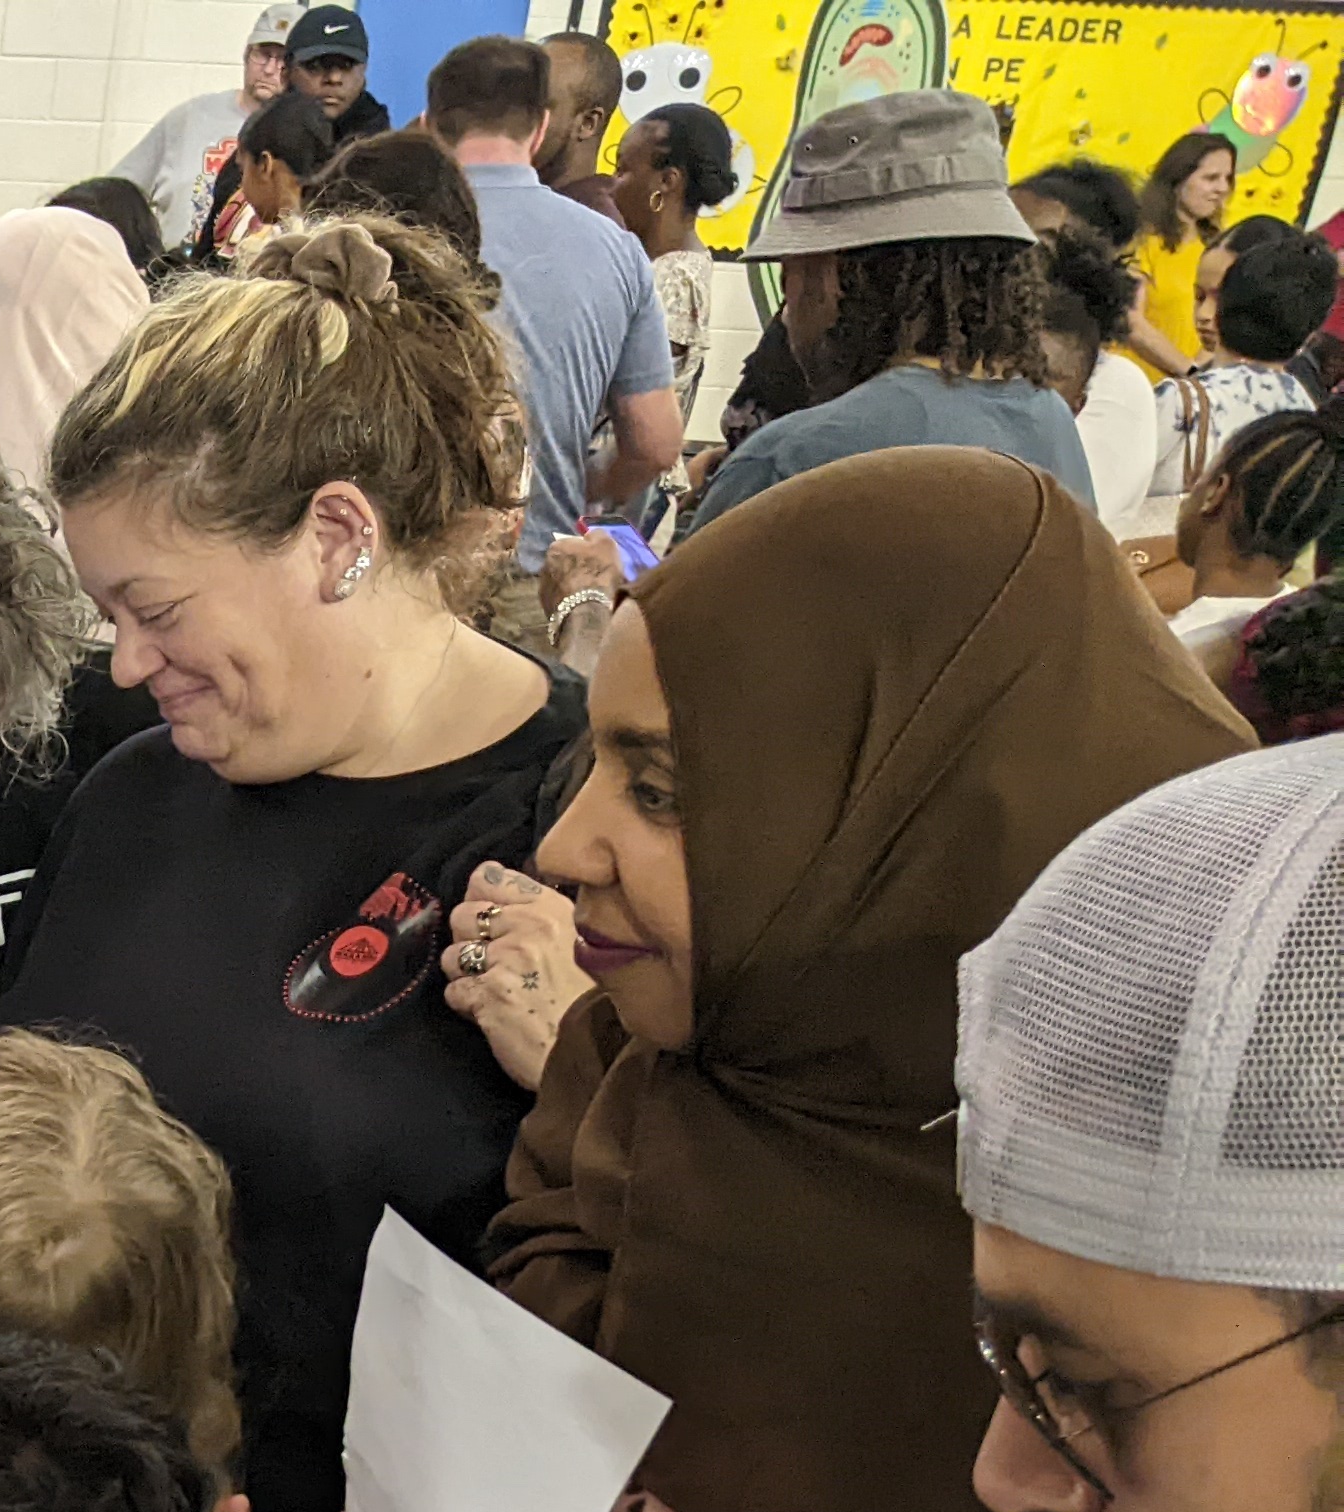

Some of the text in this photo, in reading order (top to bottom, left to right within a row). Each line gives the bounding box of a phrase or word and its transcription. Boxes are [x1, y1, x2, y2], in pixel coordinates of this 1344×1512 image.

[952, 14, 1123, 44] A LEADER
[983, 58, 1025, 83] PE
